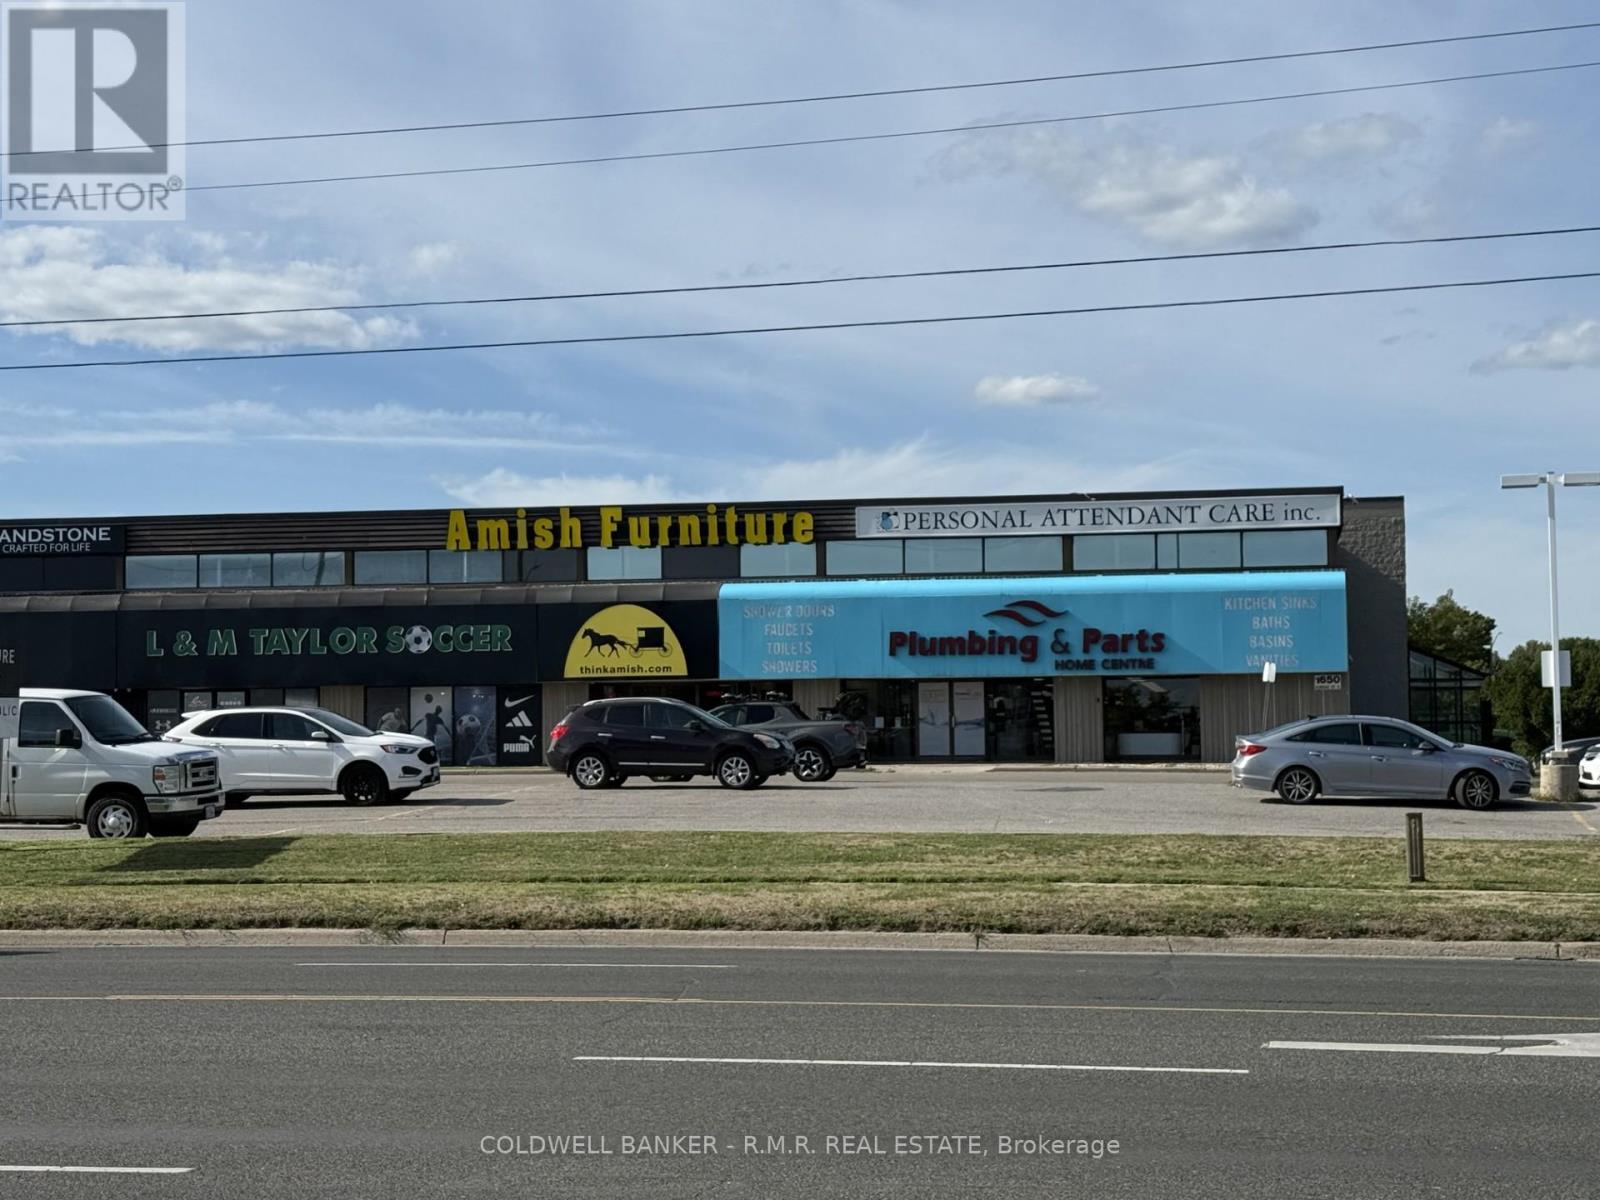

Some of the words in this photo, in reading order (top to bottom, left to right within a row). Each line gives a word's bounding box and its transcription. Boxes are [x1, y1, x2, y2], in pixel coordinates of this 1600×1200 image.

[904, 510, 1032, 530] PERSONAL
[1041, 505, 1201, 526] ATTENDANT
[1209, 503, 1275, 523] CARE
[1284, 503, 1320, 521] inc.
[446, 508, 583, 550] Amish
[600, 503, 815, 547] Furniture
[2, 543, 47, 553] CRAFTED
[49, 543, 69, 552] FOR
[71, 542, 91, 552] LIFE
[1224, 597, 1276, 610] KITCHEN
[1281, 596, 1317, 609] SINKS
[743, 604, 792, 618] SHOWER
[796, 603, 836, 617] DOORS
[764, 623, 814, 636] FAUCETS
[1252, 616, 1290, 629] BATHS
[146, 630, 165, 657] L
[173, 630, 199, 656] &
[207, 628, 238, 656] M
[249, 626, 378, 655] TAYLOR
[767, 641, 812, 655] TOILETS
[888, 629, 1040, 663] Plumbing
[1050, 628, 1071, 654] &
[1082, 627, 1166, 654] Parts
[1249, 635, 1294, 648] BASINS
[0, 649, 15, 664] RE
[580, 664, 672, 674] thinkamish.com
[761, 659, 817, 673] SHOWERS
[1054, 659, 1096, 671] HOME
[1101, 658, 1156, 670] CENTRE
[503, 743, 530, 753] PUMA
